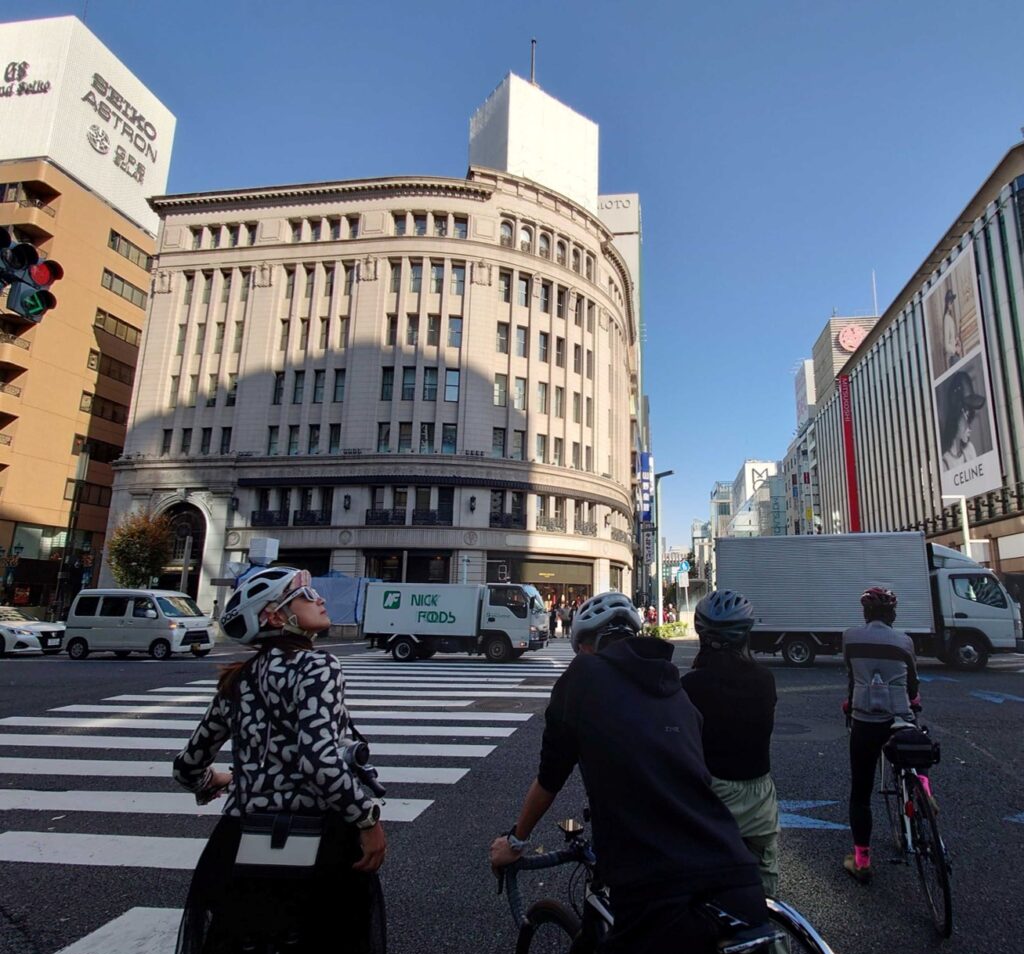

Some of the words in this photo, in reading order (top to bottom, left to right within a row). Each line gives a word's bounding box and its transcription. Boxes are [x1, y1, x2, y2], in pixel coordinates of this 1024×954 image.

[91, 73, 157, 141] SEIKO
[81, 90, 157, 164] ASTRON
[953, 464, 985, 487] CELINE
[410, 593, 439, 607] NICK
[417, 610, 456, 624] FOODS
